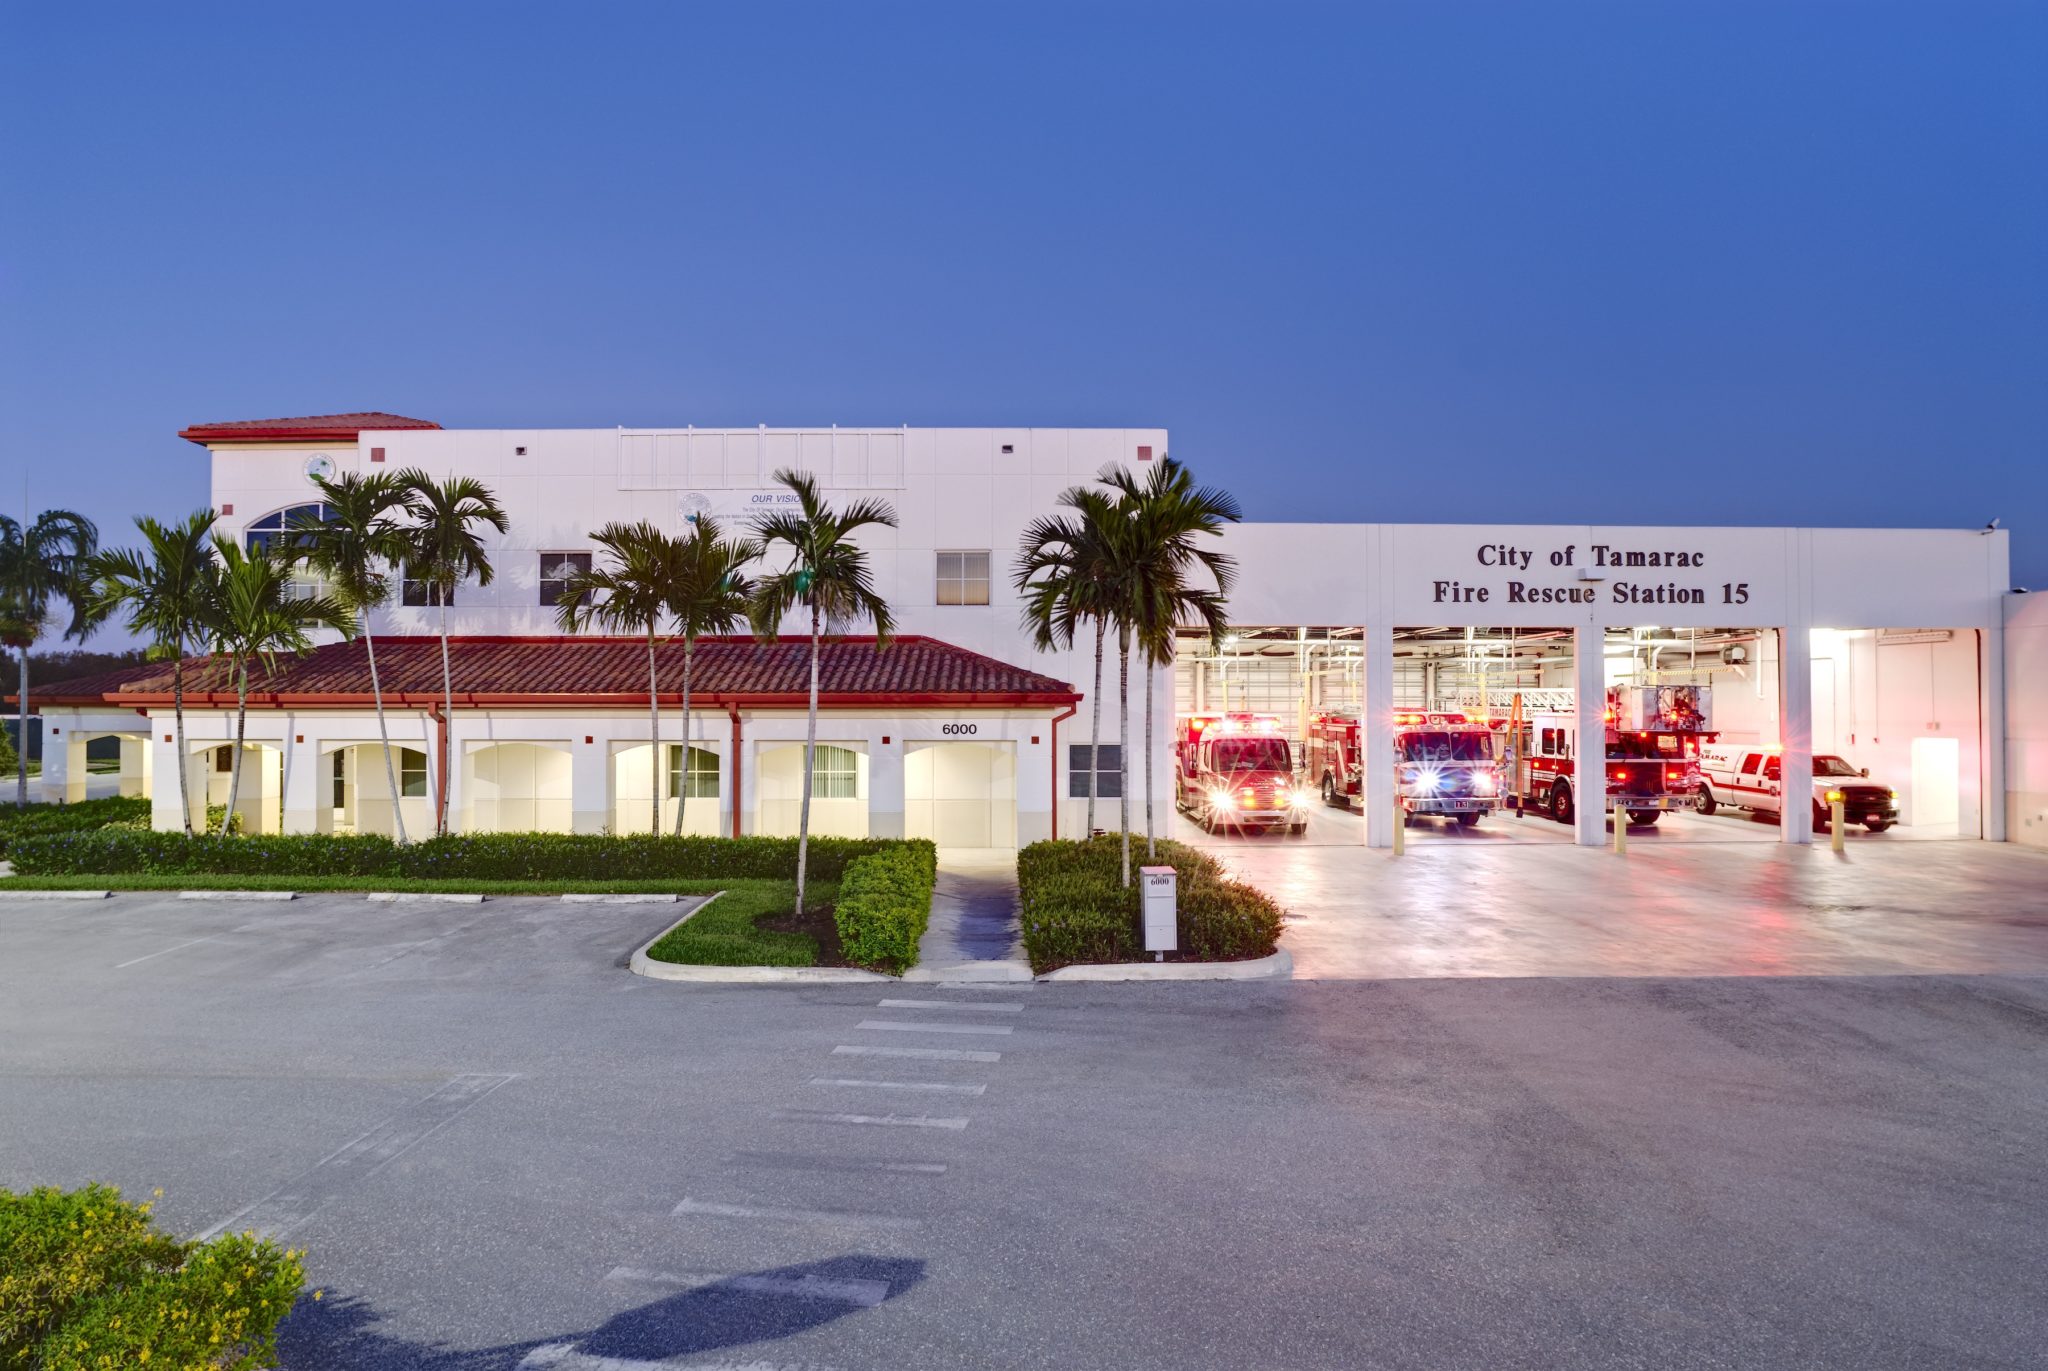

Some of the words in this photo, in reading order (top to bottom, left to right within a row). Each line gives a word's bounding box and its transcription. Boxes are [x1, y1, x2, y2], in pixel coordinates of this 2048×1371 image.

[751, 494, 774, 503] OUR
[776, 494, 803, 503] VISIO
[1477, 544, 1533, 571] City
[1550, 545, 1575, 567] of
[1591, 545, 1704, 567] Tamarac
[1433, 581, 1489, 603] Fire
[1507, 581, 1596, 604] Rescue
[1613, 582, 1705, 604] Station
[1722, 583, 1750, 604] 15
[942, 724, 977, 735] 6000
[1151, 877, 1169, 885] 6000
